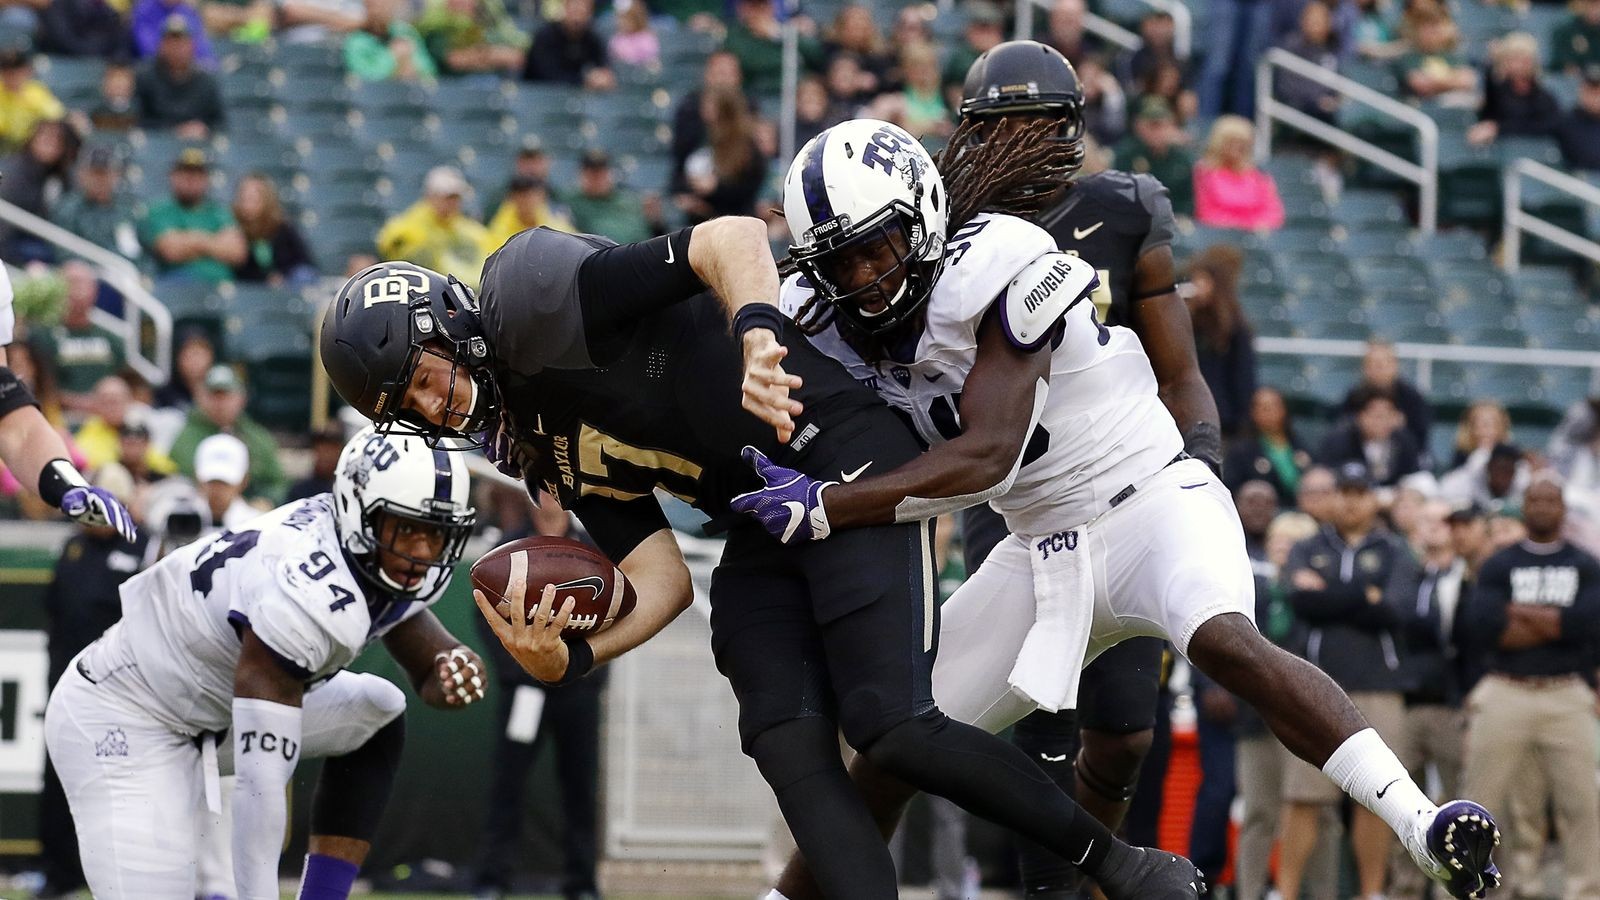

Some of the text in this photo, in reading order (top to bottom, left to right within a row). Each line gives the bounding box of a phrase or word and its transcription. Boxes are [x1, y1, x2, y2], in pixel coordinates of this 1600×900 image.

[813, 219, 839, 237] FROGS
[1023, 259, 1072, 314] DOUGLAS
[553, 435, 575, 490] BAYLOR
[1037, 530, 1079, 561] TCU
[299, 551, 357, 613] 94
[241, 730, 298, 763] TCU
